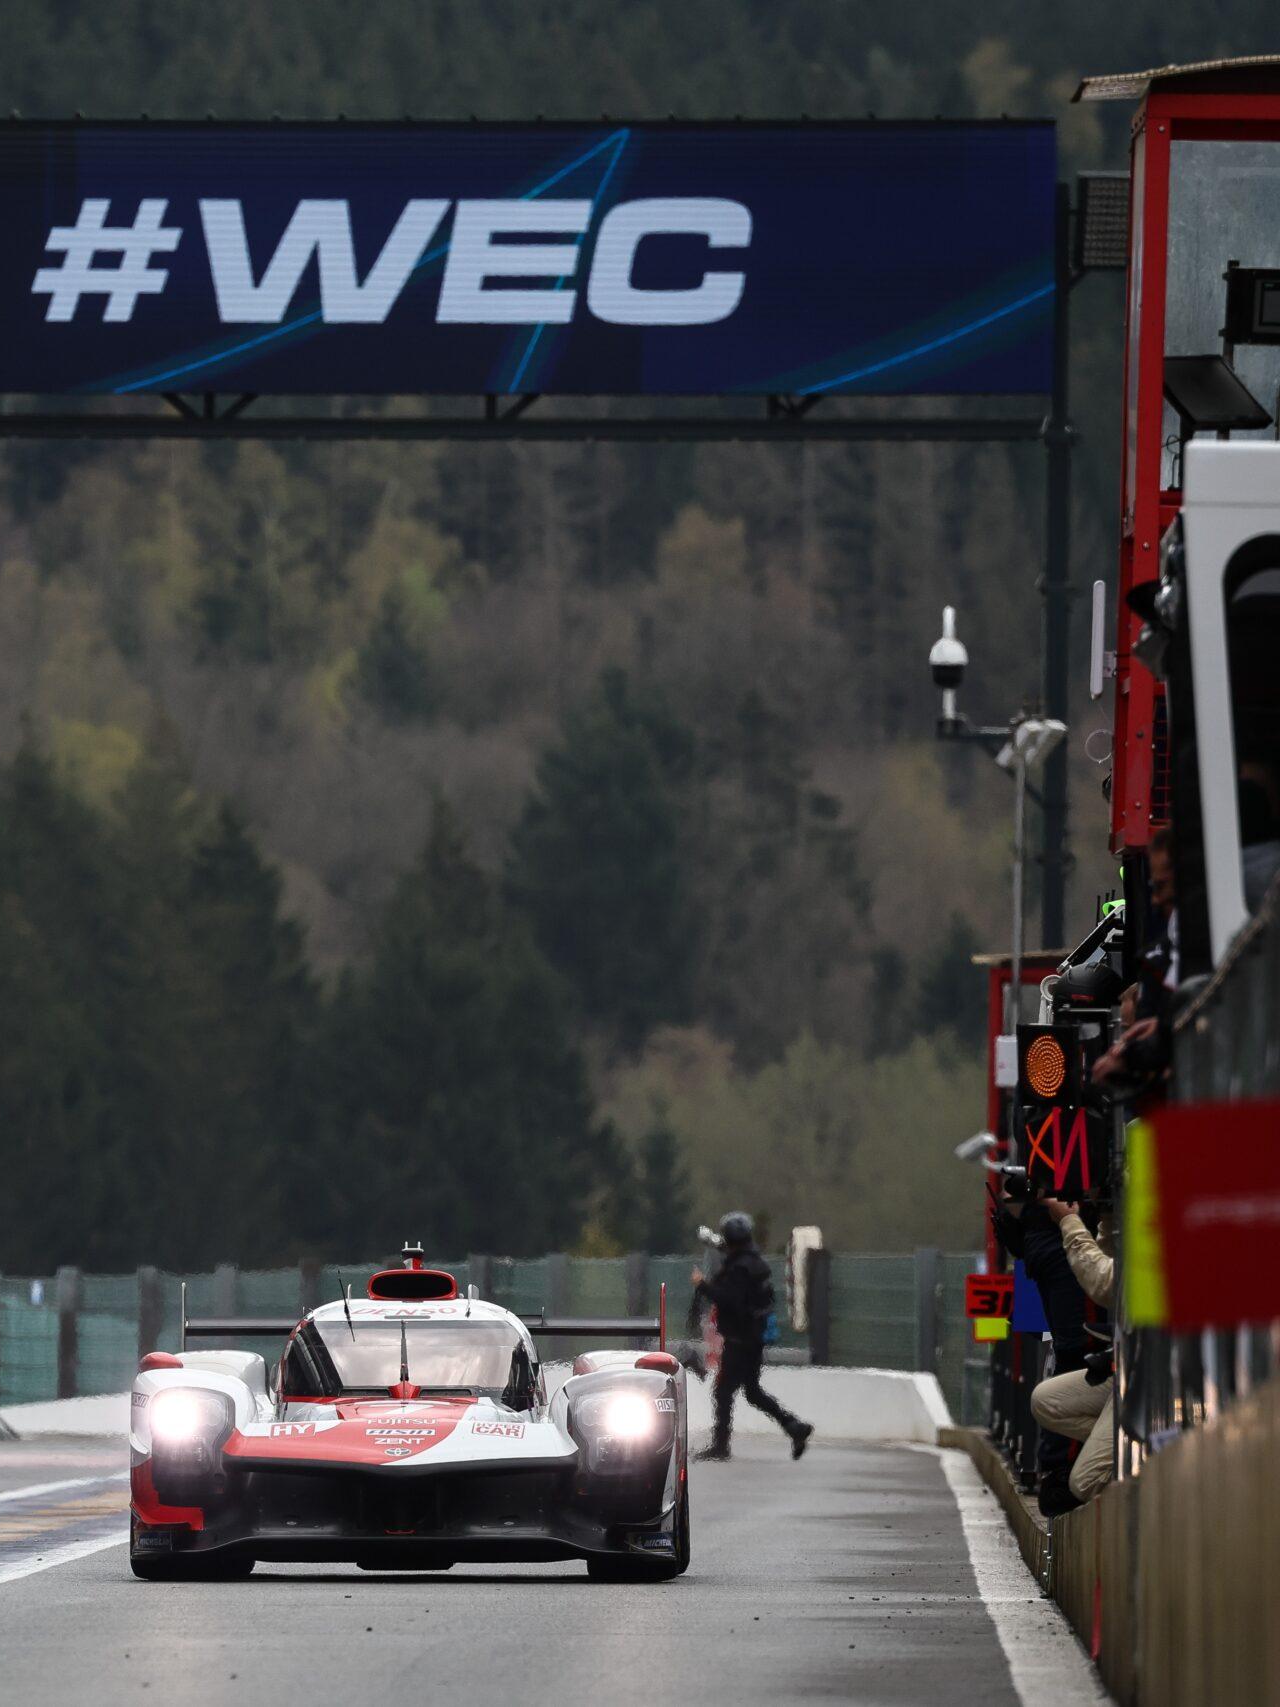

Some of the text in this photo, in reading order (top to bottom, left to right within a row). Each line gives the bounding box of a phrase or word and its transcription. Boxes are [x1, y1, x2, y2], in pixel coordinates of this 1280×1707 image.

[31, 197, 753, 325] #WEC
[969, 1289, 1013, 1315] 31
[351, 1307, 458, 1316] DENSO
[273, 1423, 313, 1437] HY
[476, 1422, 521, 1430] HYPER
[476, 1426, 520, 1437] CAR
[374, 1437, 426, 1445] ZENT
